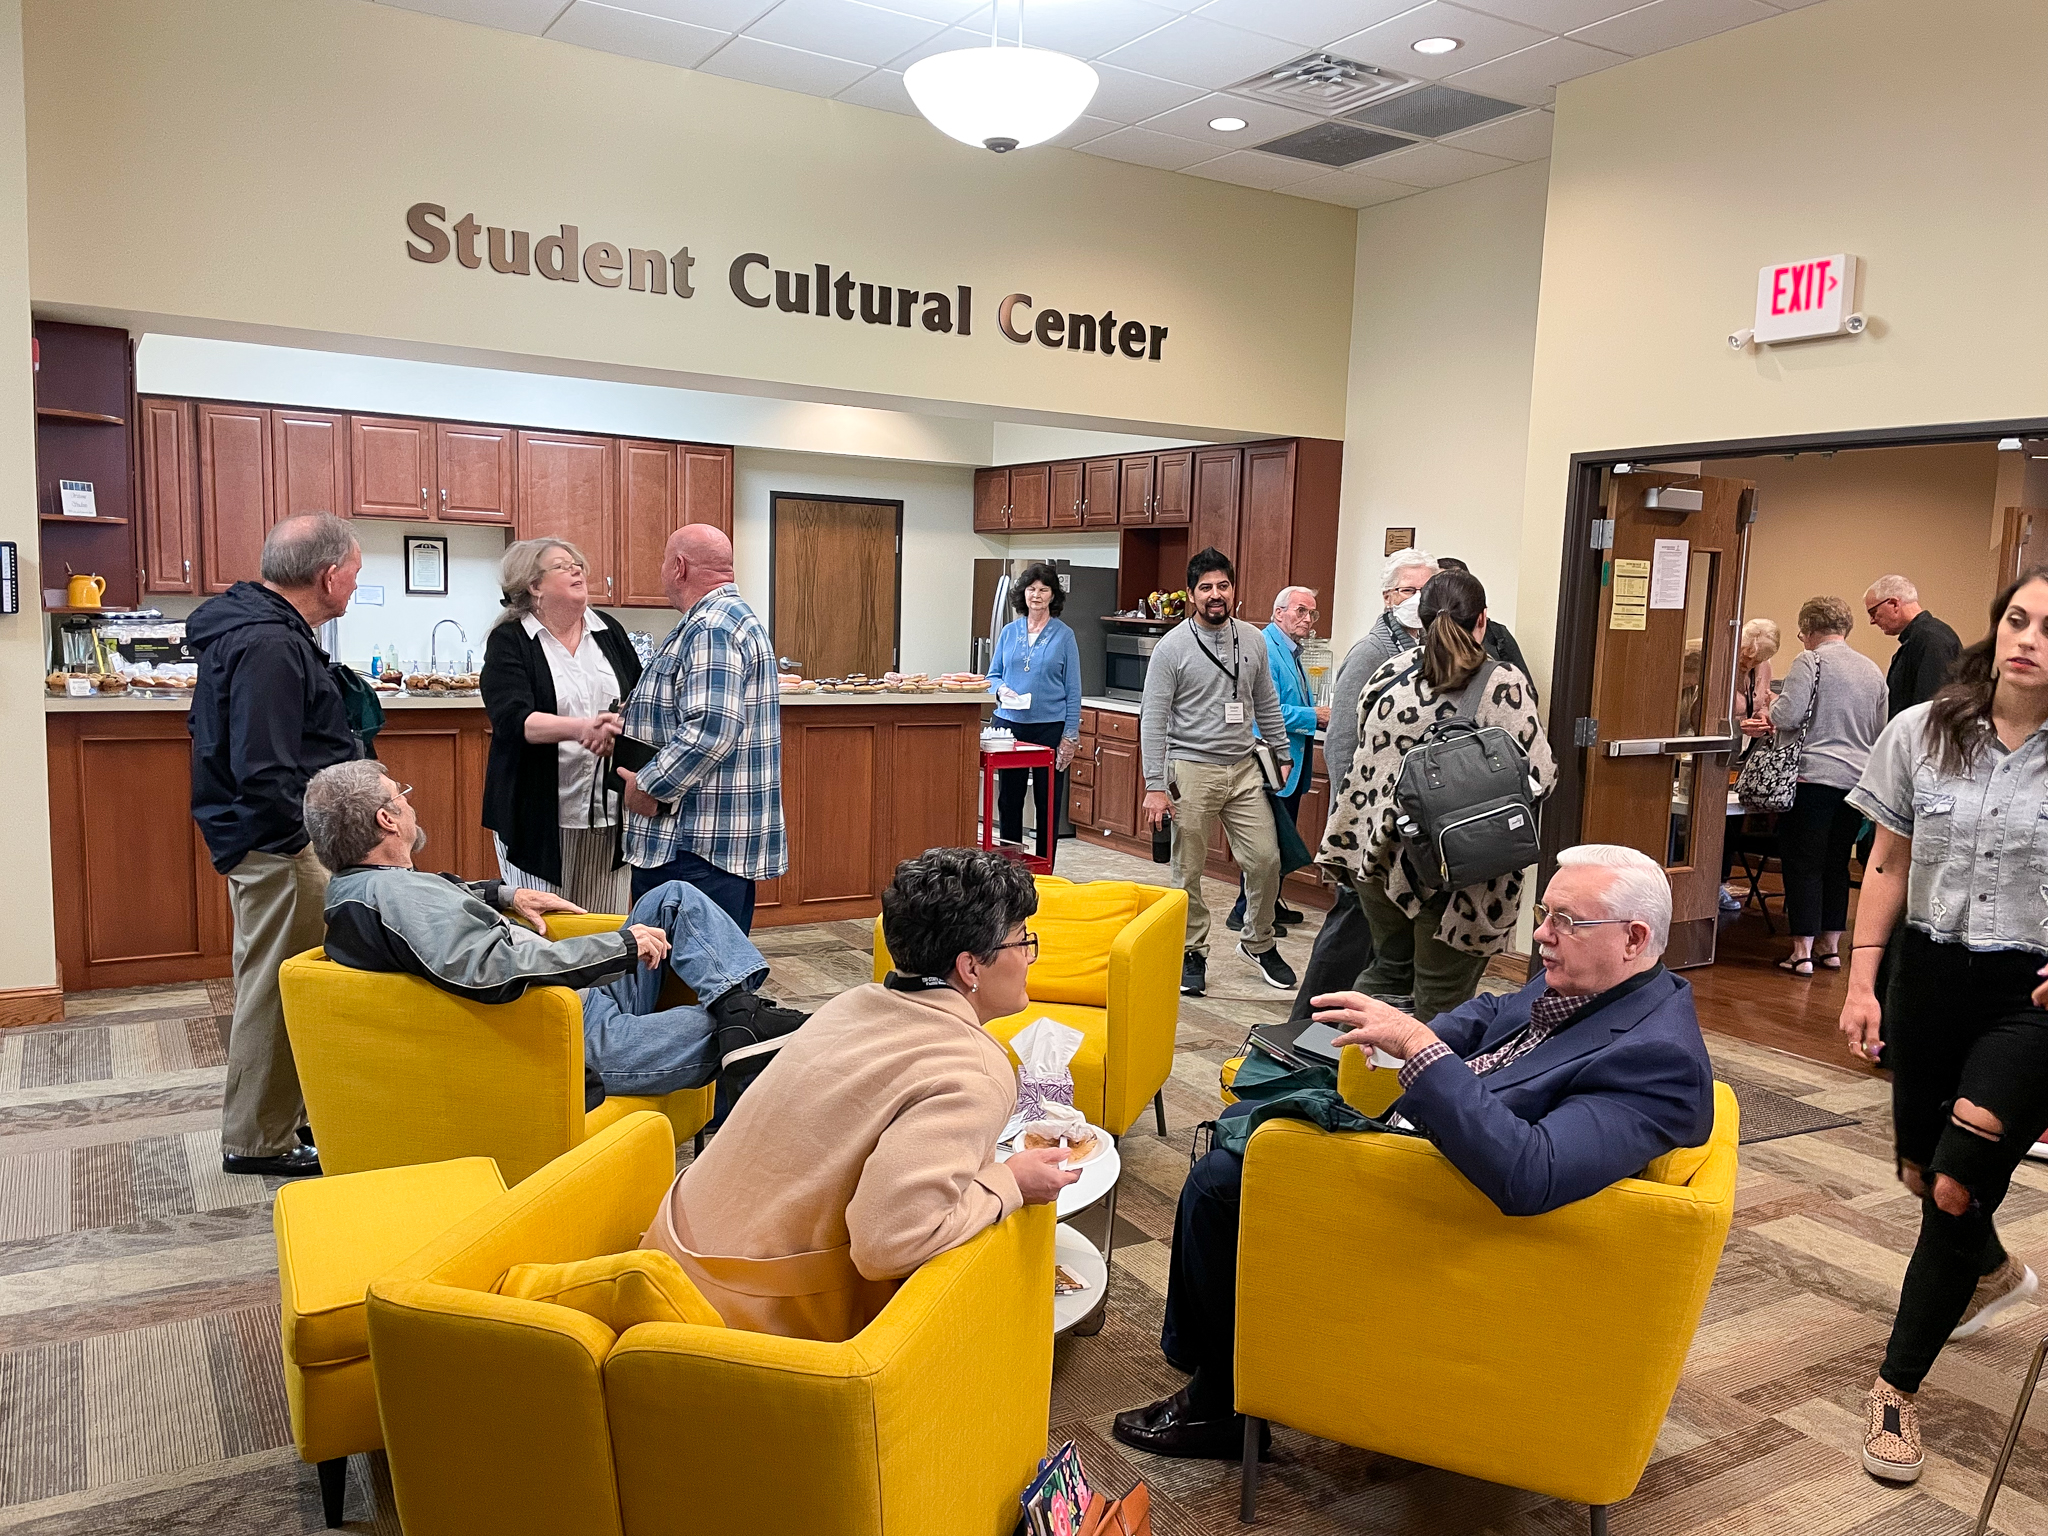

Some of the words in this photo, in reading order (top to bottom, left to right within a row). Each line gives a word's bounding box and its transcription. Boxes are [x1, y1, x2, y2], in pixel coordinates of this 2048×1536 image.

[406, 202, 696, 299] Student
[728, 252, 972, 336] Cultural
[997, 292, 1169, 362] Center
[1771, 259, 1832, 316] EXIT
